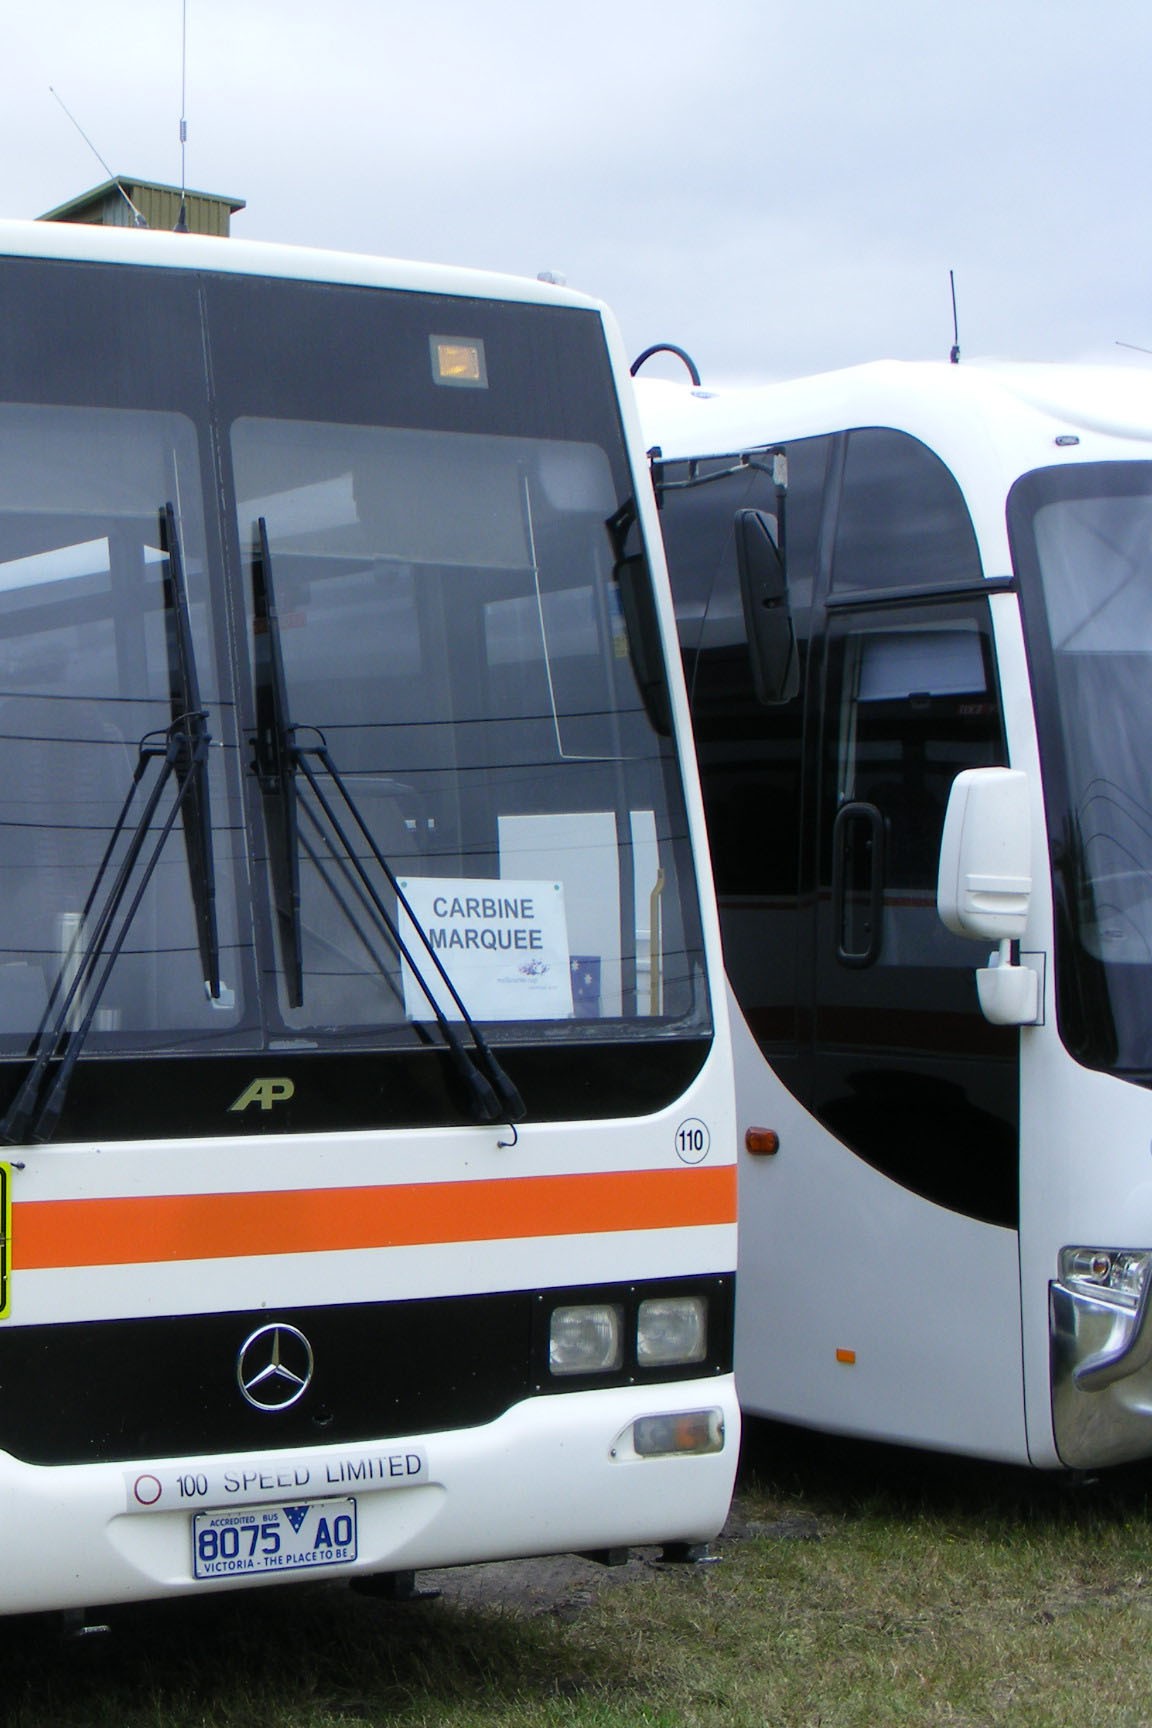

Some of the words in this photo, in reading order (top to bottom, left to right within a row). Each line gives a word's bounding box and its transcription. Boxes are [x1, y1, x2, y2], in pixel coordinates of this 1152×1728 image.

[433, 896, 535, 919] CARBINE
[428, 928, 544, 951] MARQUEE
[228, 1076, 295, 1111] AP
[679, 1129, 703, 1151] 110
[176, 1472, 209, 1497] 100
[224, 1465, 311, 1493] SPEED
[326, 1454, 422, 1483] LIMITED
[209, 1514, 256, 1527] ACCREDITED
[262, 1513, 279, 1523] BUS
[198, 1522, 281, 1562] 8075
[204, 1559, 255, 1573] VICTORIA
[264, 1553, 284, 1567] THE
[286, 1551, 317, 1564] PLACE
[319, 1549, 333, 1560] TO
[336, 1548, 348, 1559] BE
